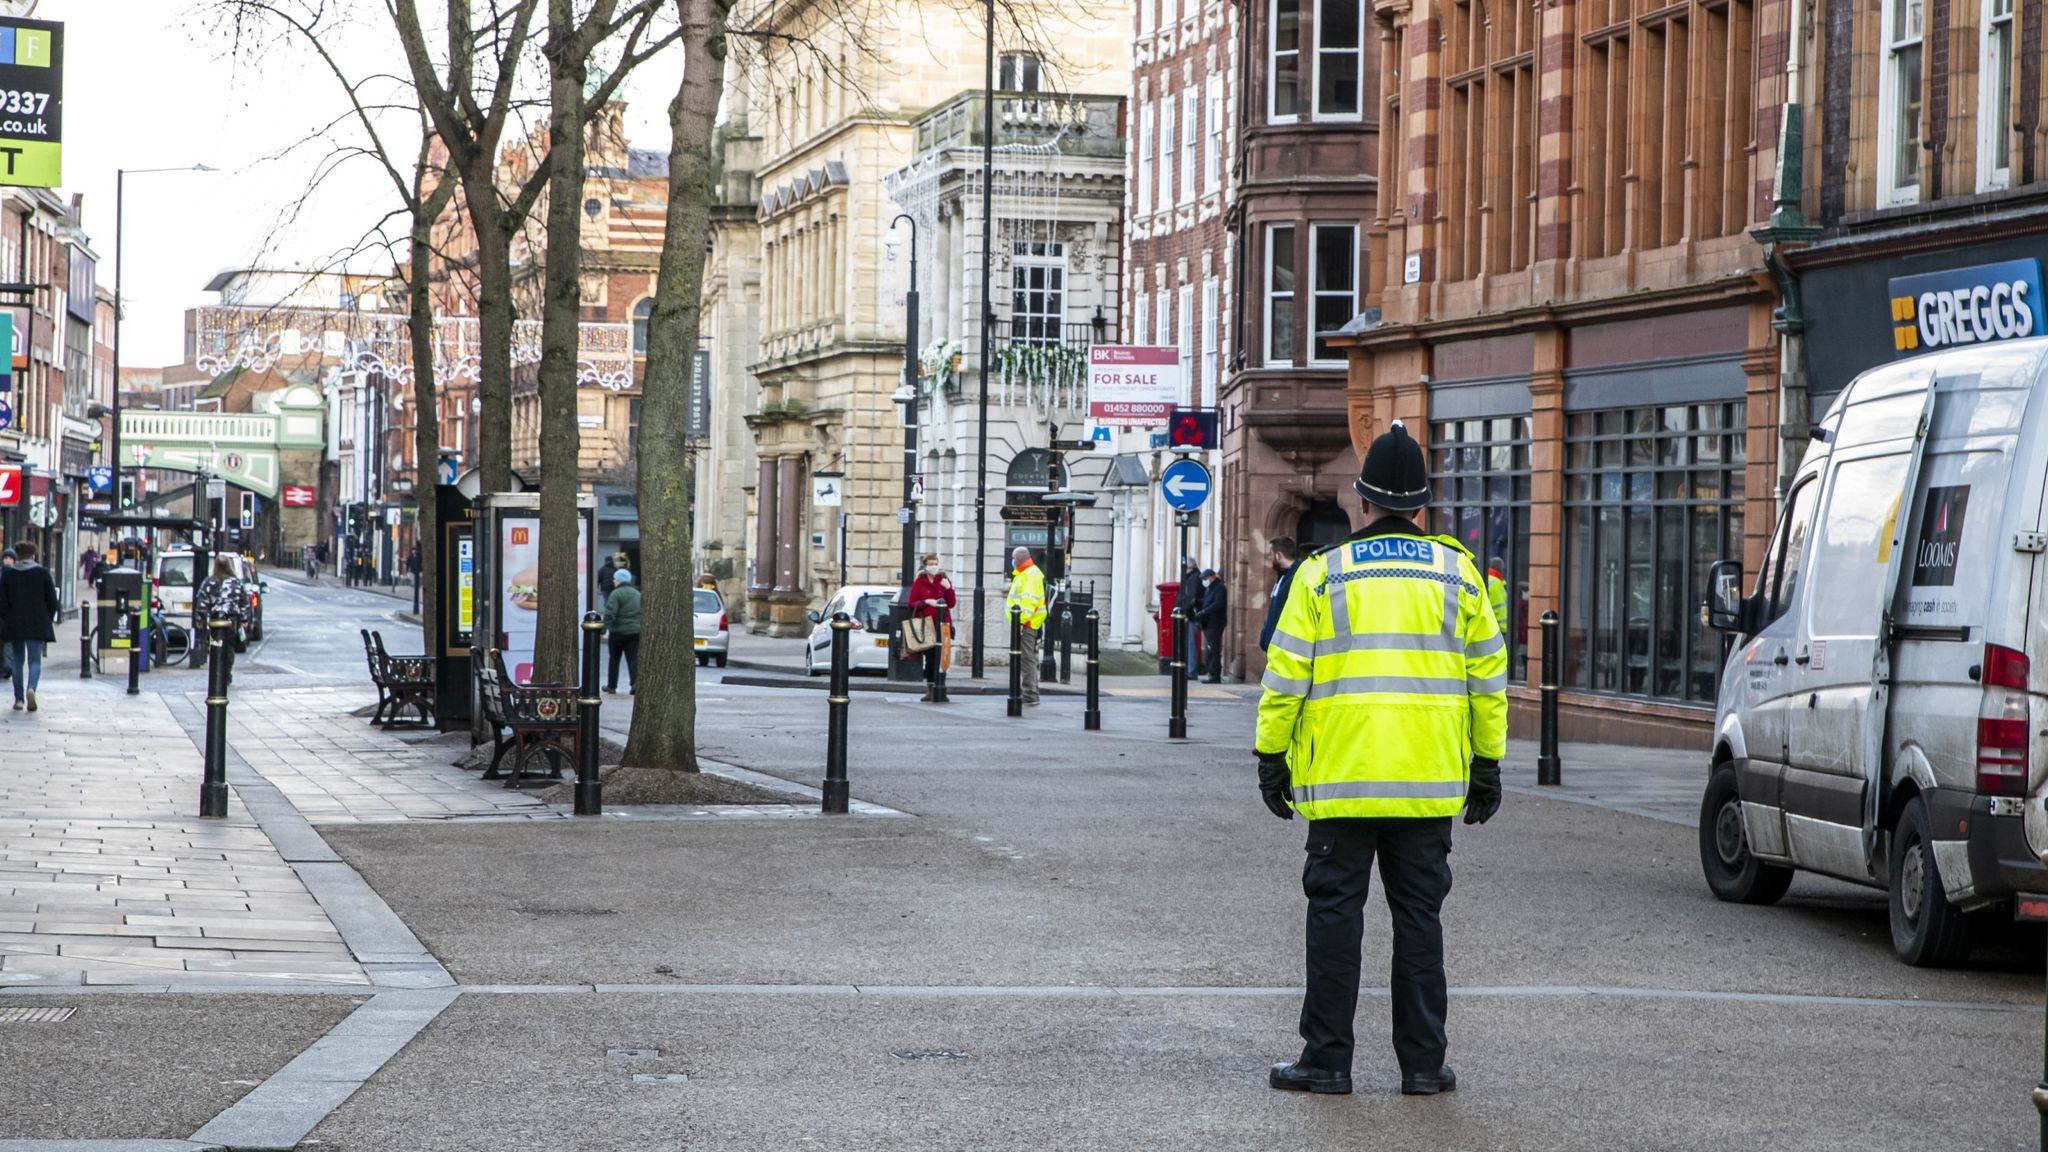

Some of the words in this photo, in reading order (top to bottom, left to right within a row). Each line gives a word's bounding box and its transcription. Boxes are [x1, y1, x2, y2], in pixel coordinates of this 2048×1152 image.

[1918, 279, 2033, 347] GREGGS
[1093, 349, 1110, 361] BK
[692, 355, 702, 396] LETTUCE
[1094, 374, 1121, 385] FOR
[1125, 374, 1157, 385] SALE
[692, 406, 702, 429] SLUG
[1103, 404, 1130, 413] 01452
[1355, 540, 1431, 560] POLICE
[1919, 539, 1957, 568] LOOMIS
